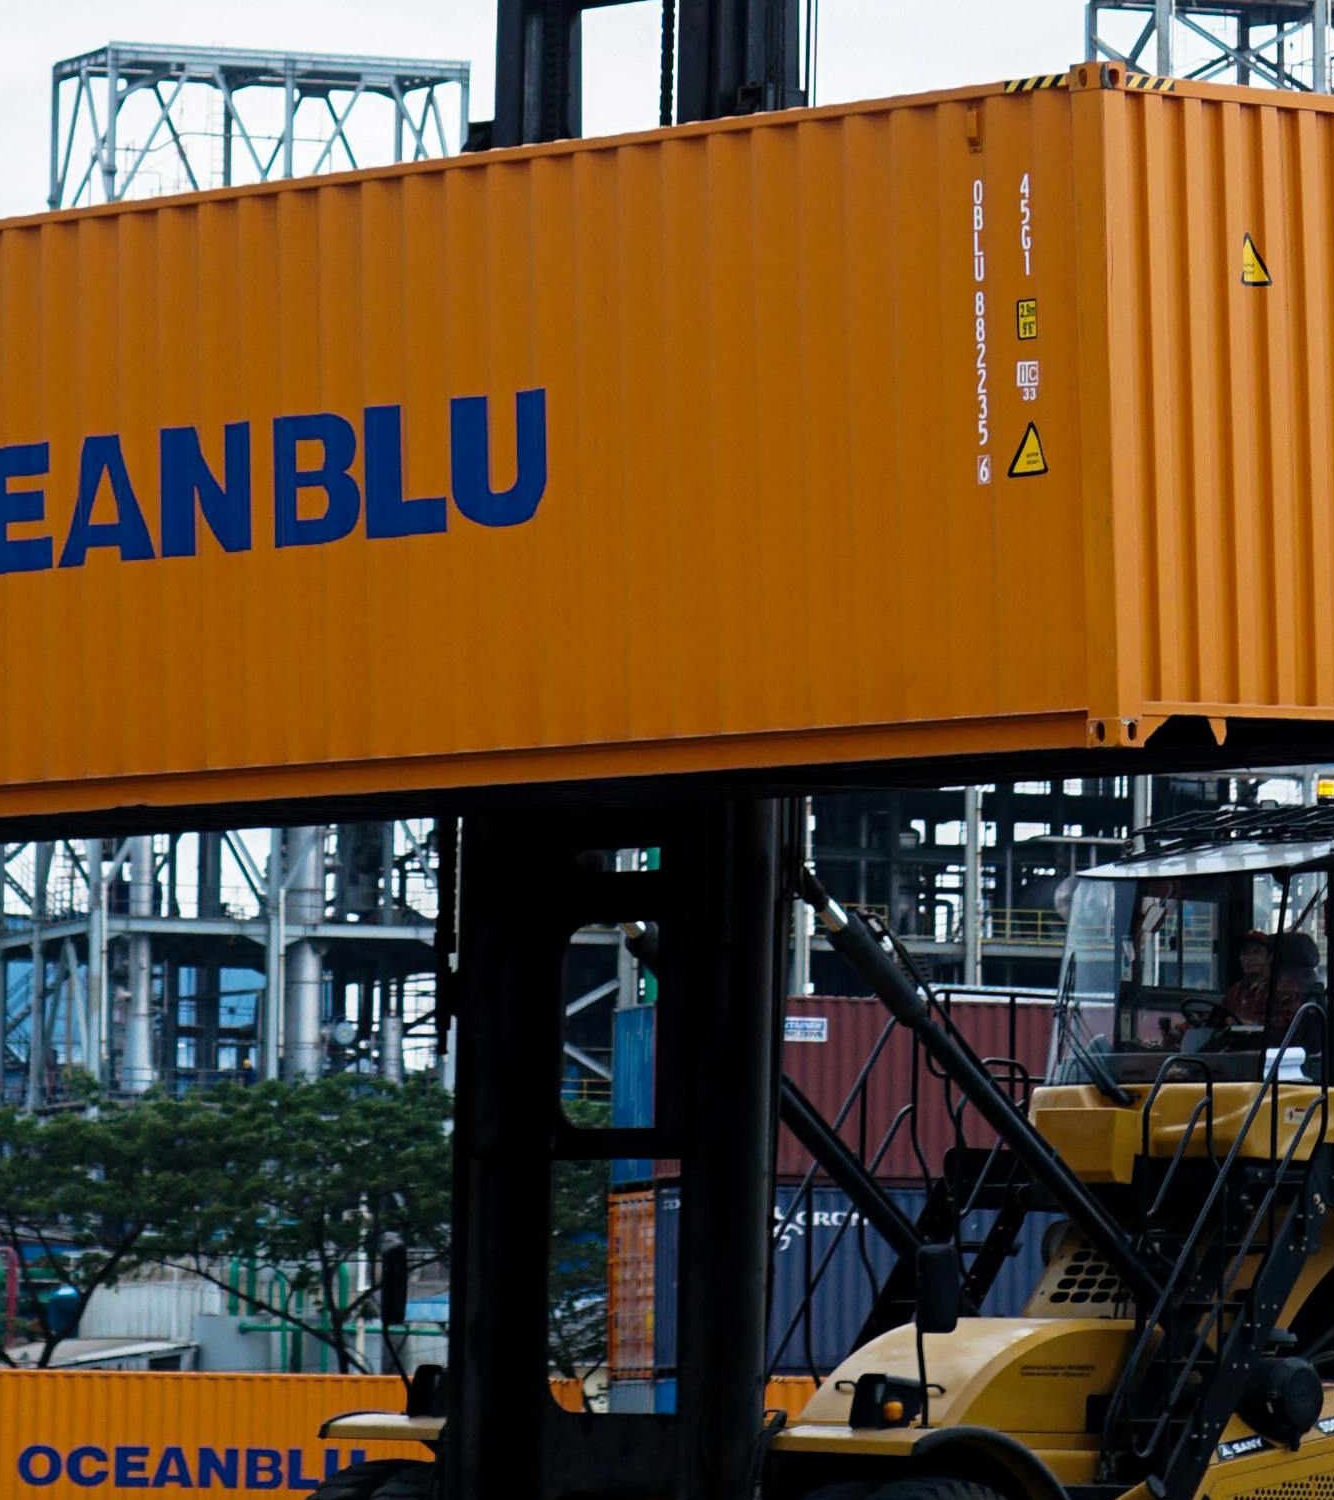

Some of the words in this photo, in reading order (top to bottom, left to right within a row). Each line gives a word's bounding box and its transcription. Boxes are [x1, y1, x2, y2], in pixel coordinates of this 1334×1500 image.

[973, 179, 985, 282] OBLU
[1019, 173, 1032, 276] 45G1
[975, 291, 989, 446] 882235
[1022, 387, 1036, 401] 33
[978, 456, 990, 484] 6
